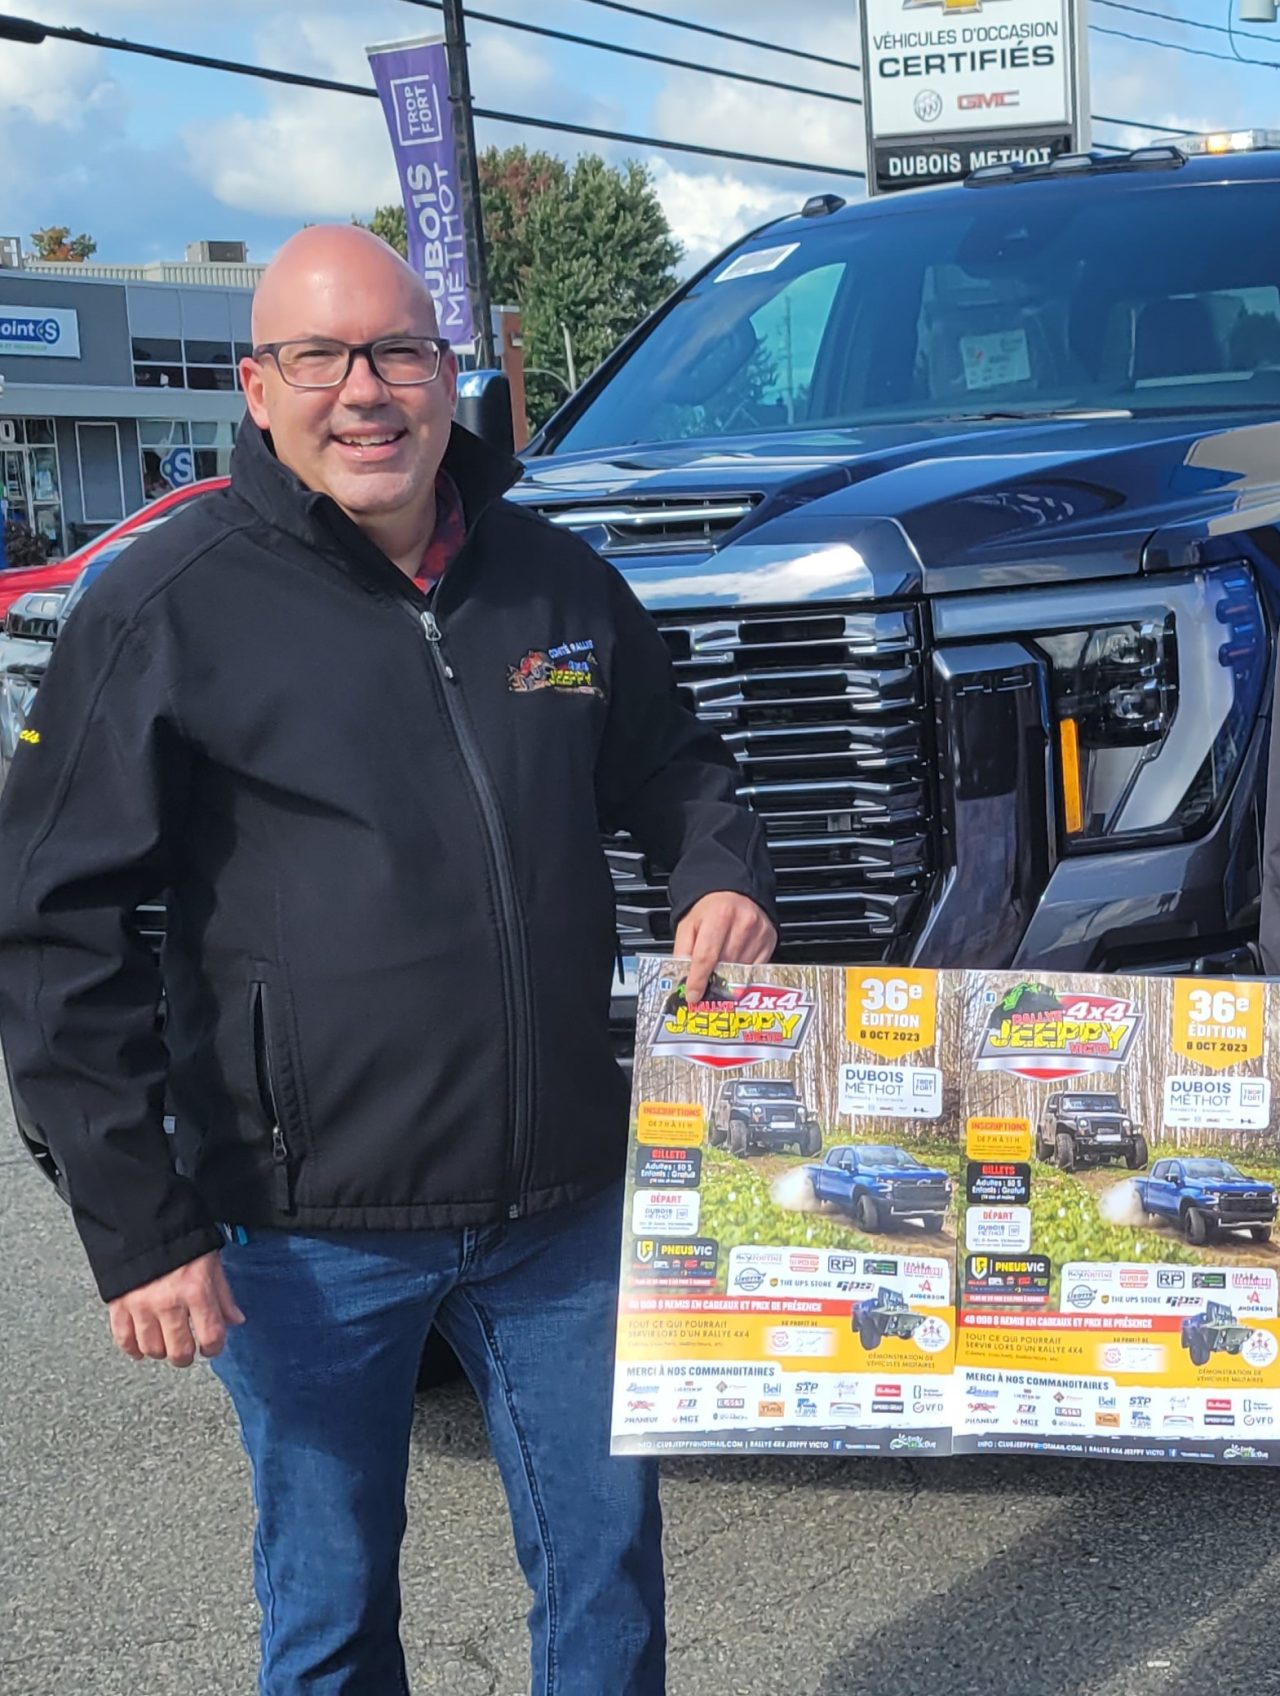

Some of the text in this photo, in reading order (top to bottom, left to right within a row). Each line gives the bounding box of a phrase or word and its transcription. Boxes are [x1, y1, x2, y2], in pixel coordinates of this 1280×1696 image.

[873, 21, 1059, 50] VÉHICULES D'OCCASION
[879, 40, 1055, 78] CERTIFIÉS
[414, 85, 435, 133] FORT
[957, 90, 1020, 110] GMC
[404, 87, 421, 135] TROP
[888, 153, 962, 177] DUBOIS
[860, 977, 922, 1011] 36e
[1188, 988, 1250, 1025] 36e
[664, 1005, 802, 1039] JEEPPY
[860, 1009, 919, 1028] ÉDITION
[869, 1030, 890, 1040] OCT
[892, 1031, 920, 1041] 2023
[989, 1017, 1129, 1052] JEEPPY
[1187, 1020, 1246, 1040] ÉDITION
[1196, 1041, 1216, 1051] OCT
[1219, 1042, 1247, 1052] 2023
[844, 1080, 903, 1096] MÉTHOT
[1170, 1092, 1231, 1106] MÉTHOT
[982, 1208, 1013, 1220] DÉPART
[830, 1258, 854, 1271] RP
[1159, 1273, 1182, 1285] RP
[626, 1364, 775, 1376] MERCI À NOS COMMANDITAIRES
[965, 1371, 1109, 1391] MERCI À NOS COMMANDITAIRES
